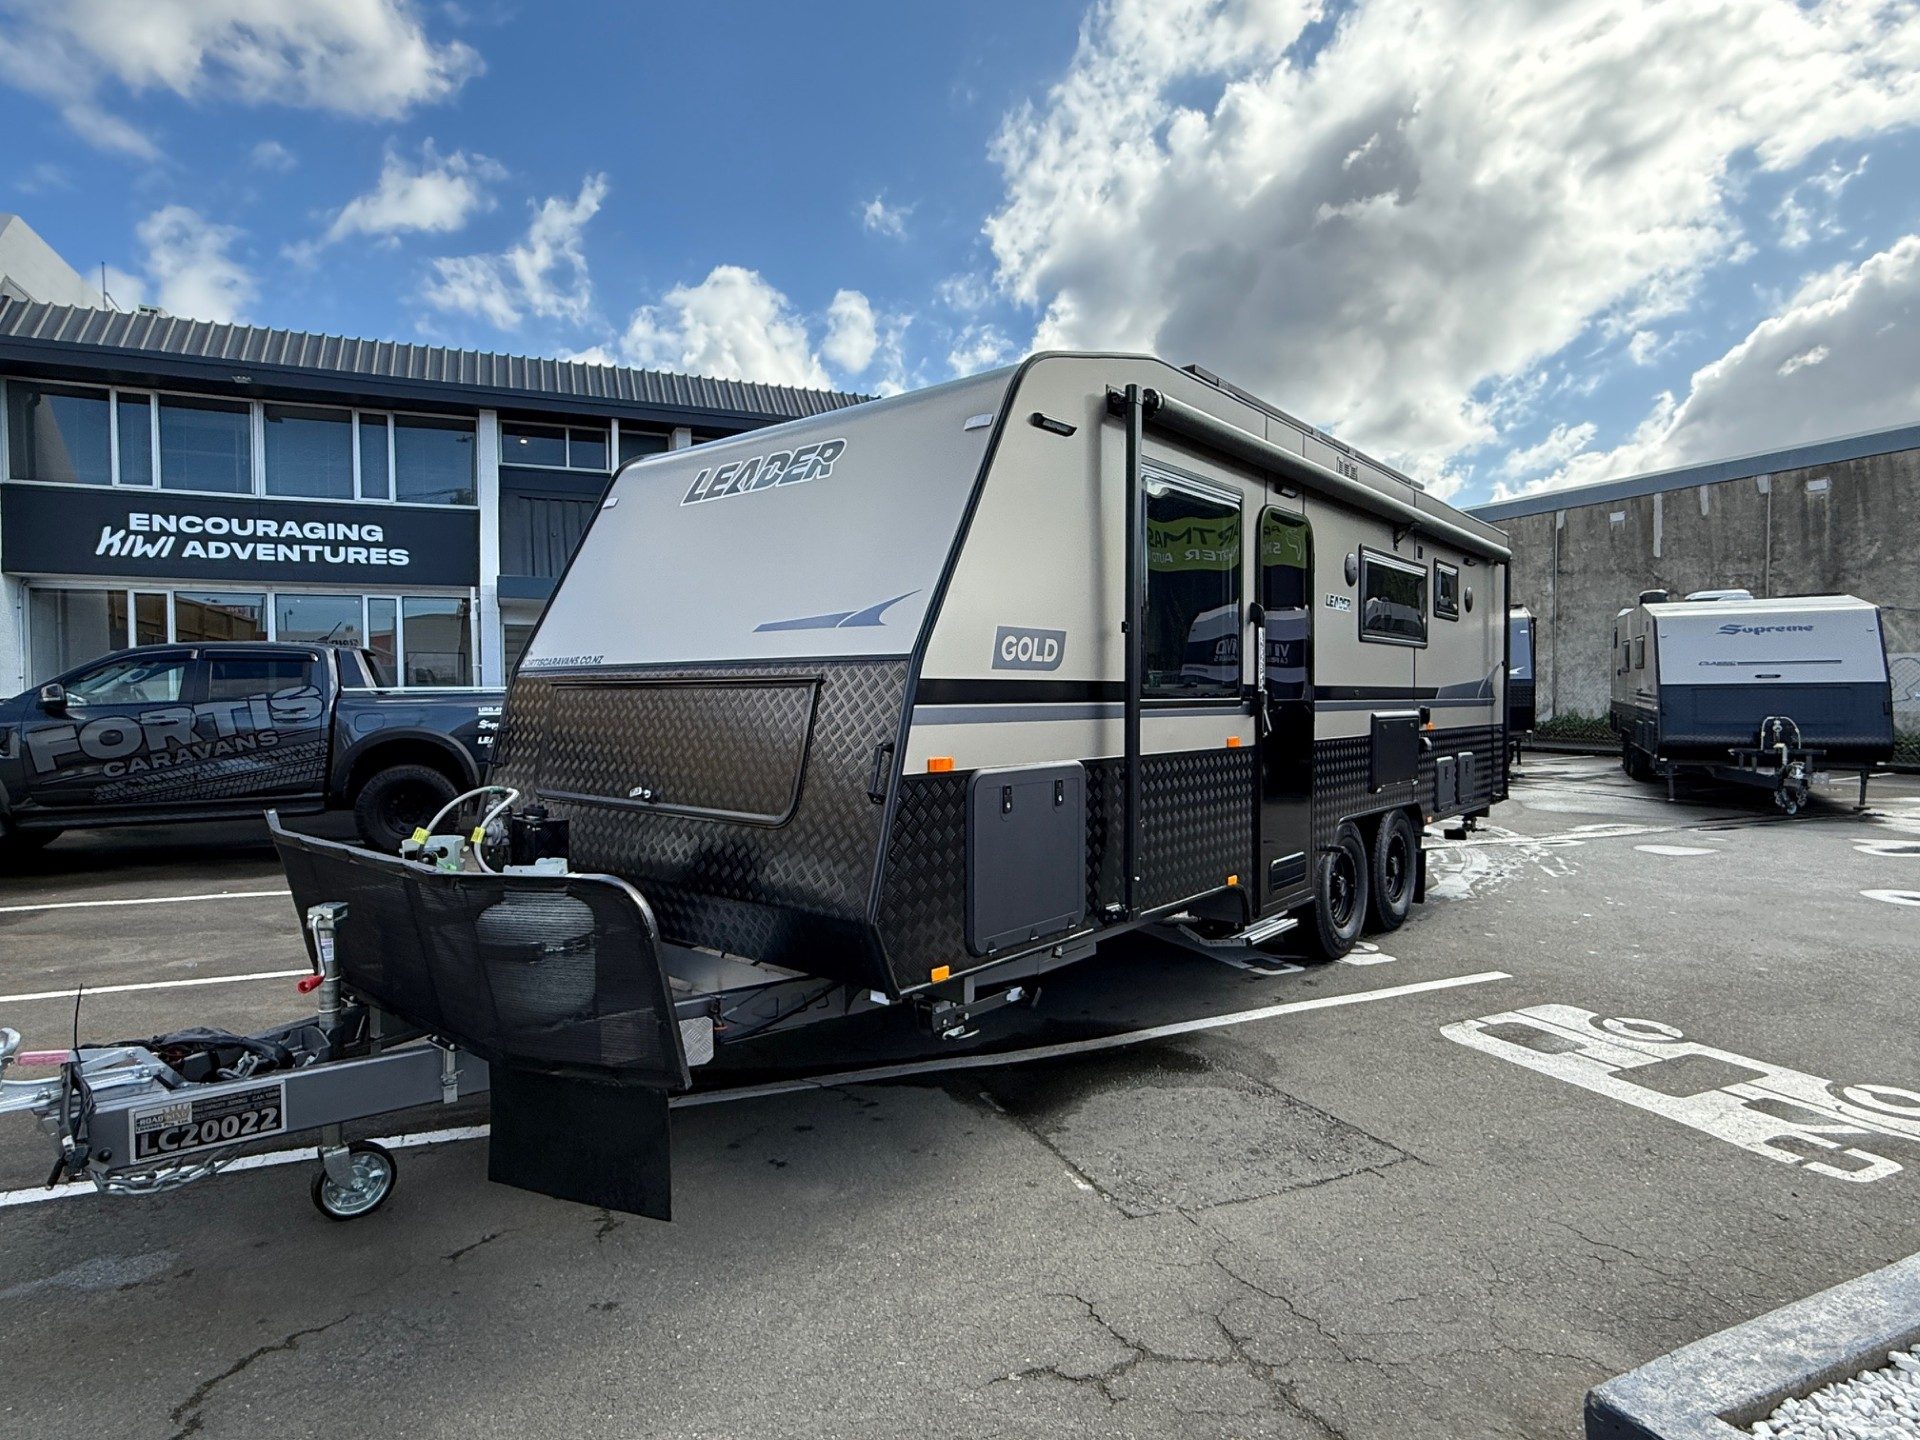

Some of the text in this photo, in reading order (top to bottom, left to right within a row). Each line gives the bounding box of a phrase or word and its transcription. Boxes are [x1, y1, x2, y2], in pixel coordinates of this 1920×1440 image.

[680, 438, 847, 506] LEADER
[95, 525, 410, 566] KIWI ADVENTURES
[128, 512, 384, 542] ENCOURAGING
[1325, 593, 1351, 611] LEADER
[1001, 635, 1059, 662] GOLD
[1716, 624, 1814, 635] Supreme
[26, 685, 324, 775] FORTIS
[103, 730, 279, 777] CARAVANS
[139, 1107, 277, 1156] LC20022
